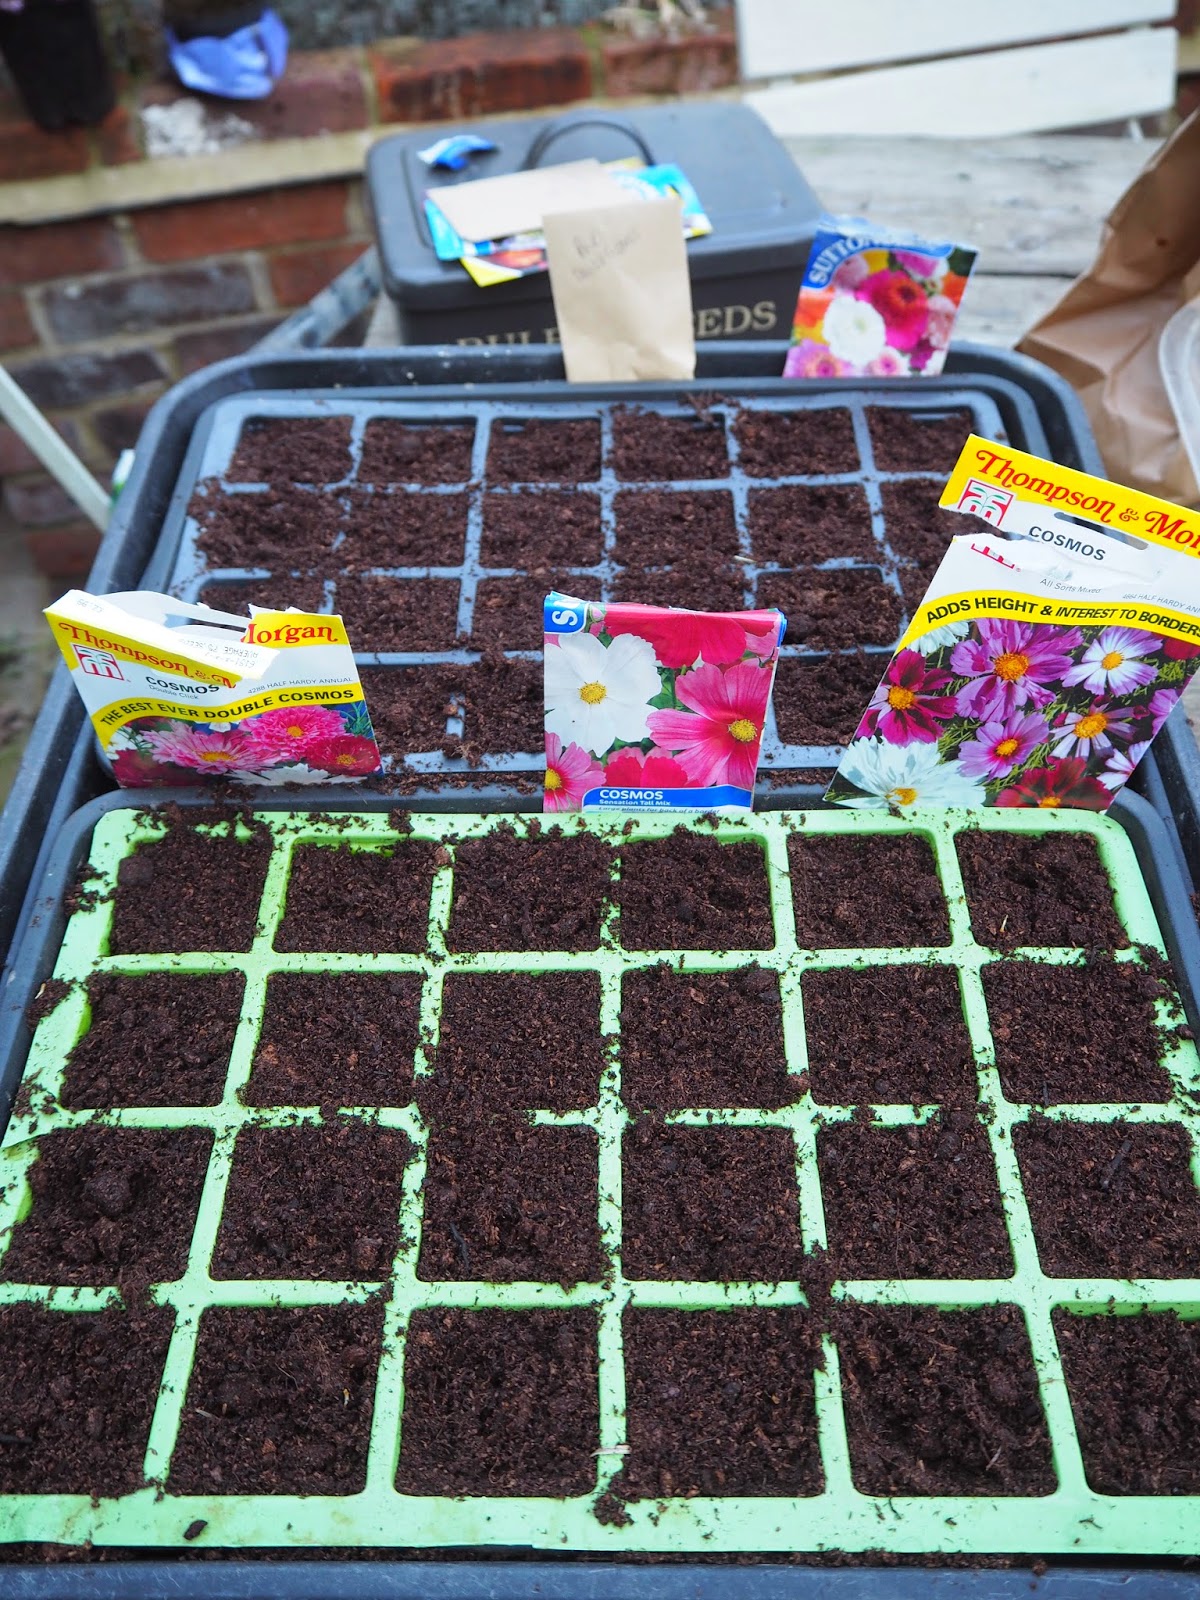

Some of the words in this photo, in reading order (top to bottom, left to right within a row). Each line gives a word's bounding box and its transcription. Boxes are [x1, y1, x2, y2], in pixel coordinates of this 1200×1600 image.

[695, 301, 777, 338] EDS
[976, 450, 1116, 523] Thompson
[1119, 508, 1139, 522] &
[1144, 510, 1200, 555] Mor
[1029, 526, 1106, 561] COSMOS
[1040, 578, 1053, 587] All
[1055, 583, 1076, 592] Sorts
[927, 599, 971, 623] ADDS
[974, 597, 1038, 614] HEIGHT
[1040, 605, 1053, 616] &
[1055, 607, 1118, 618] INTEREST
[1118, 609, 1137, 619] TO
[1157, 597, 1185, 608] HARDY
[59, 622, 194, 678] Thompson
[195, 670, 210, 680] &
[145, 676, 220, 694] COSMOS
[148, 684, 178, 697] Double
[179, 692, 199, 700] Click
[248, 685, 266, 694] 4288
[267, 681, 287, 689] HALF
[100, 709, 123, 726] THE
[120, 702, 153, 714] BEST
[157, 703, 199, 717] EVER
[203, 696, 274, 719] DOUBLE
[278, 689, 355, 703] COSMOS
[600, 789, 663, 800] COSMOS
